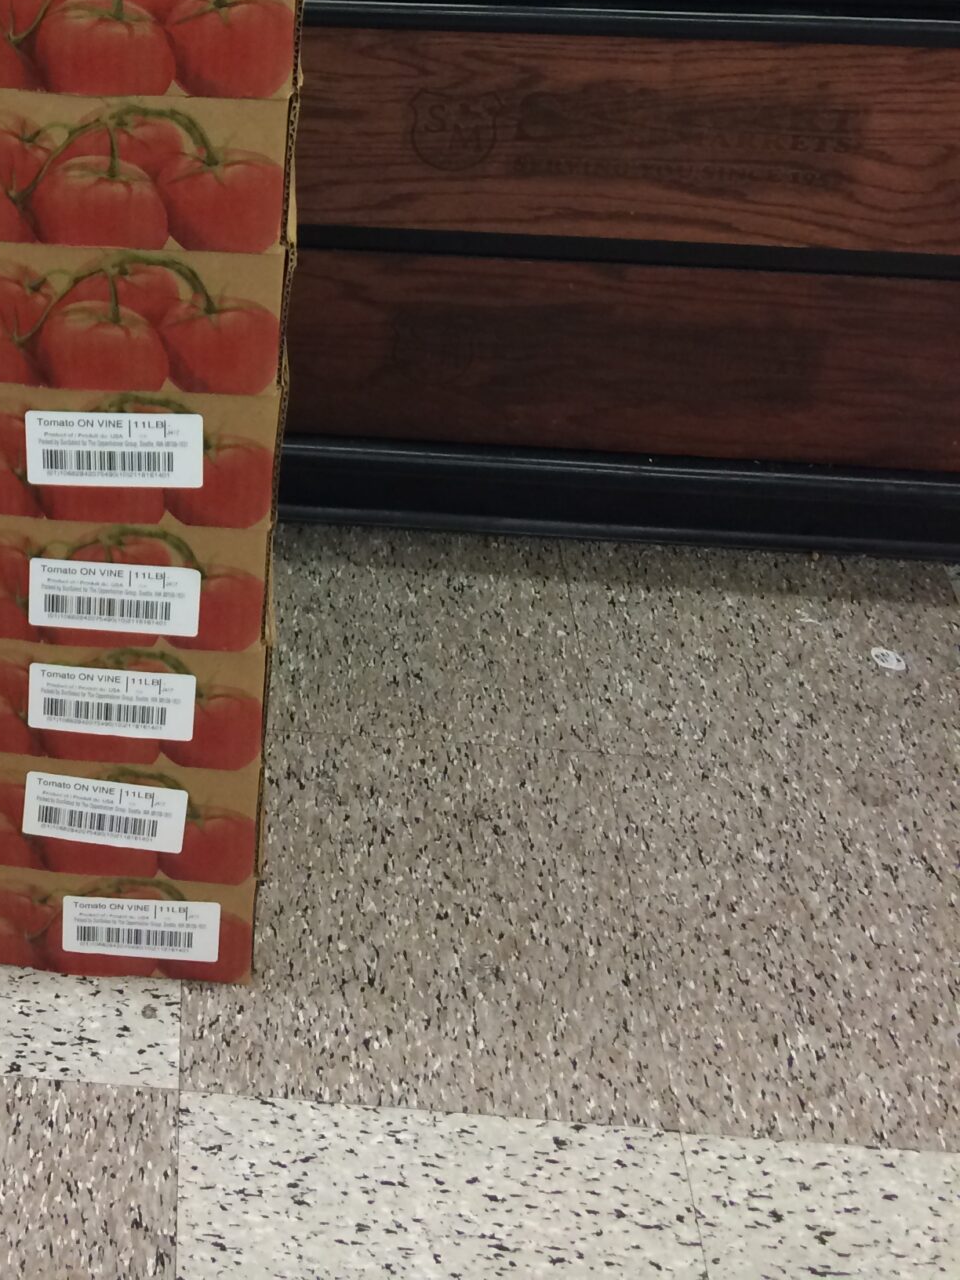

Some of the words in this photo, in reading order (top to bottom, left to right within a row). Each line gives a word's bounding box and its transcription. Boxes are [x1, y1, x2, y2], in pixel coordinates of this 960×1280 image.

[37, 417, 74, 428] Tomato
[77, 419, 94, 428] ON
[97, 420, 123, 429] VINE
[41, 564, 77, 576] Tomato
[79, 567, 96, 576] ON
[100, 569, 124, 578] VINE
[41, 669, 76, 680] Tomato
[78, 672, 94, 681] ON
[98, 675, 121, 684] VINE
[37, 778, 71, 790] Tomato
[73, 782, 89, 792] ON
[92, 785, 115, 796] VINE
[74, 901, 107, 911] Tomato
[109, 903, 125, 911] ON
[127, 904, 150, 912] VINE
